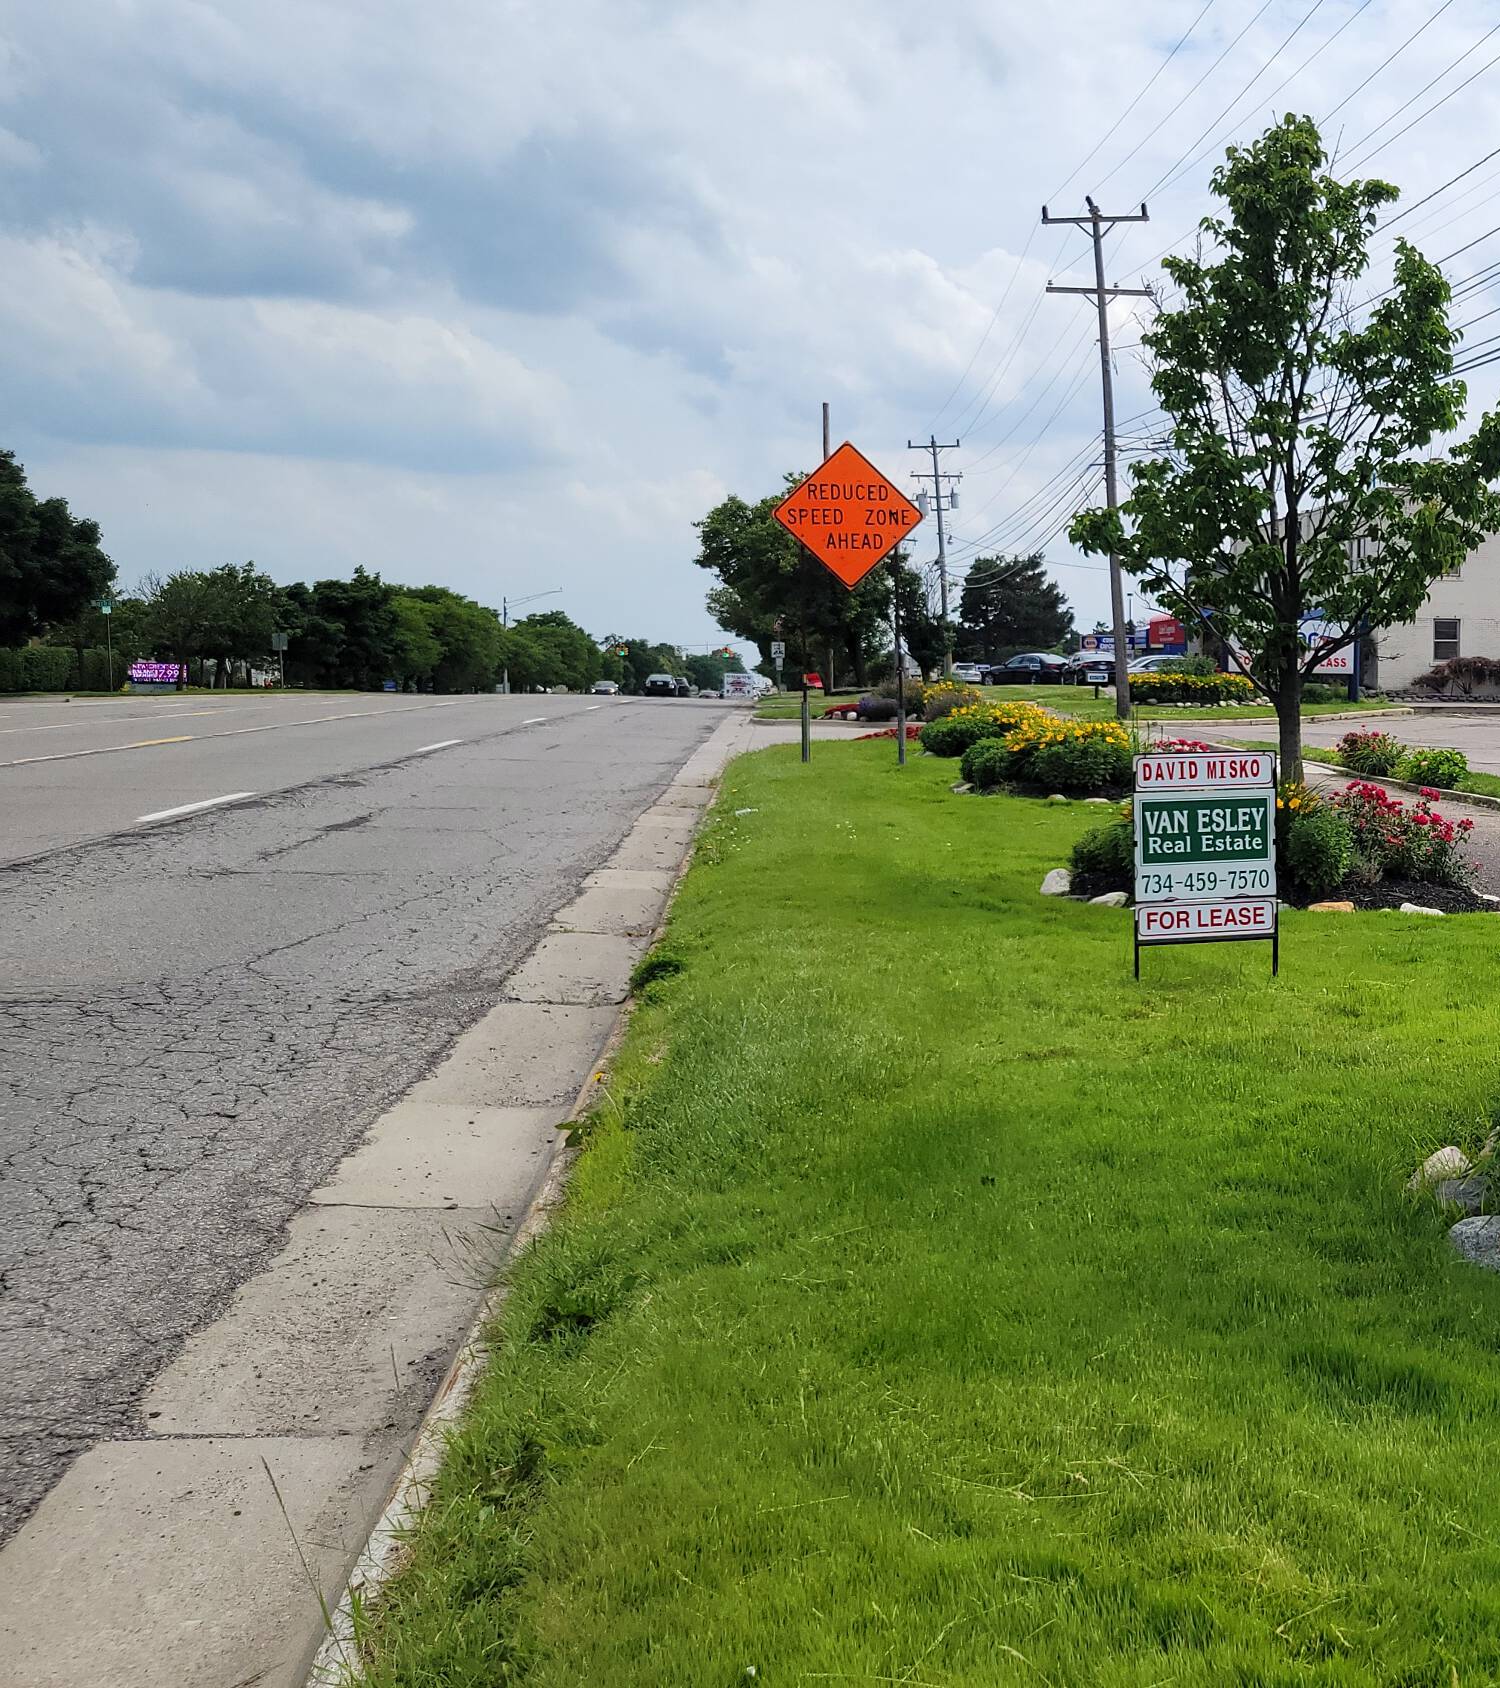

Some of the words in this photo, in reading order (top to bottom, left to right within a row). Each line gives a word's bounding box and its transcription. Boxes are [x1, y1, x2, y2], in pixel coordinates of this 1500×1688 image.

[808, 483, 889, 501] REDUCED
[787, 508, 844, 525] SPEED
[865, 509, 911, 526] ZONE
[826, 533, 884, 550] AHEAD
[1142, 760, 1198, 782] DAVID
[1207, 758, 1261, 780] MISKO
[1144, 809, 1189, 835] VAN
[1197, 807, 1265, 833] ESLEY
[1148, 836, 1192, 854] Real
[1201, 834, 1263, 852] Estate
[1141, 868, 1270, 894] 734-459-7570
[1146, 910, 1190, 930] FOR
[1197, 906, 1265, 928] LEASE
